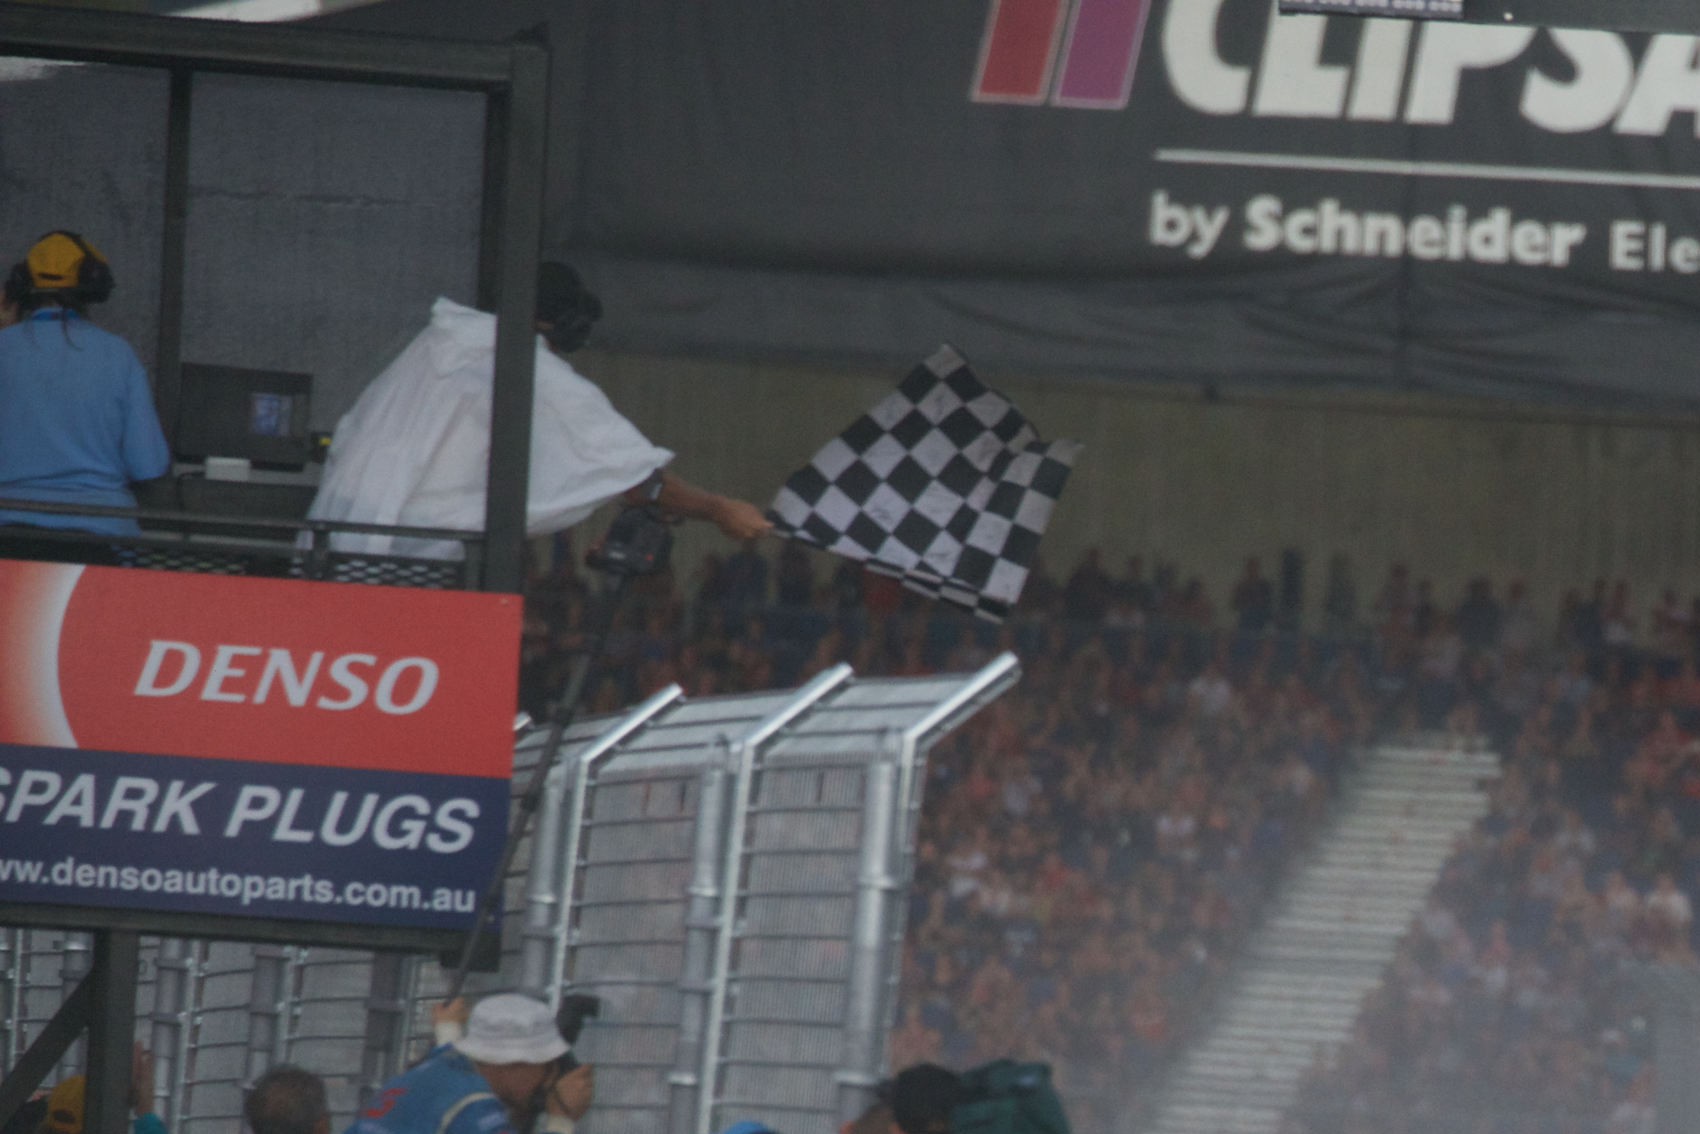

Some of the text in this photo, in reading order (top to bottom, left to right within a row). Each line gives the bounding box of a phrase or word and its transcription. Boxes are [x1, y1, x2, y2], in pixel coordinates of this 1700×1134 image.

[1148, 191, 1226, 256] by
[1243, 193, 1587, 268] Schneider
[134, 640, 439, 715] DENSO
[0, 766, 481, 854] PARK PLUGS
